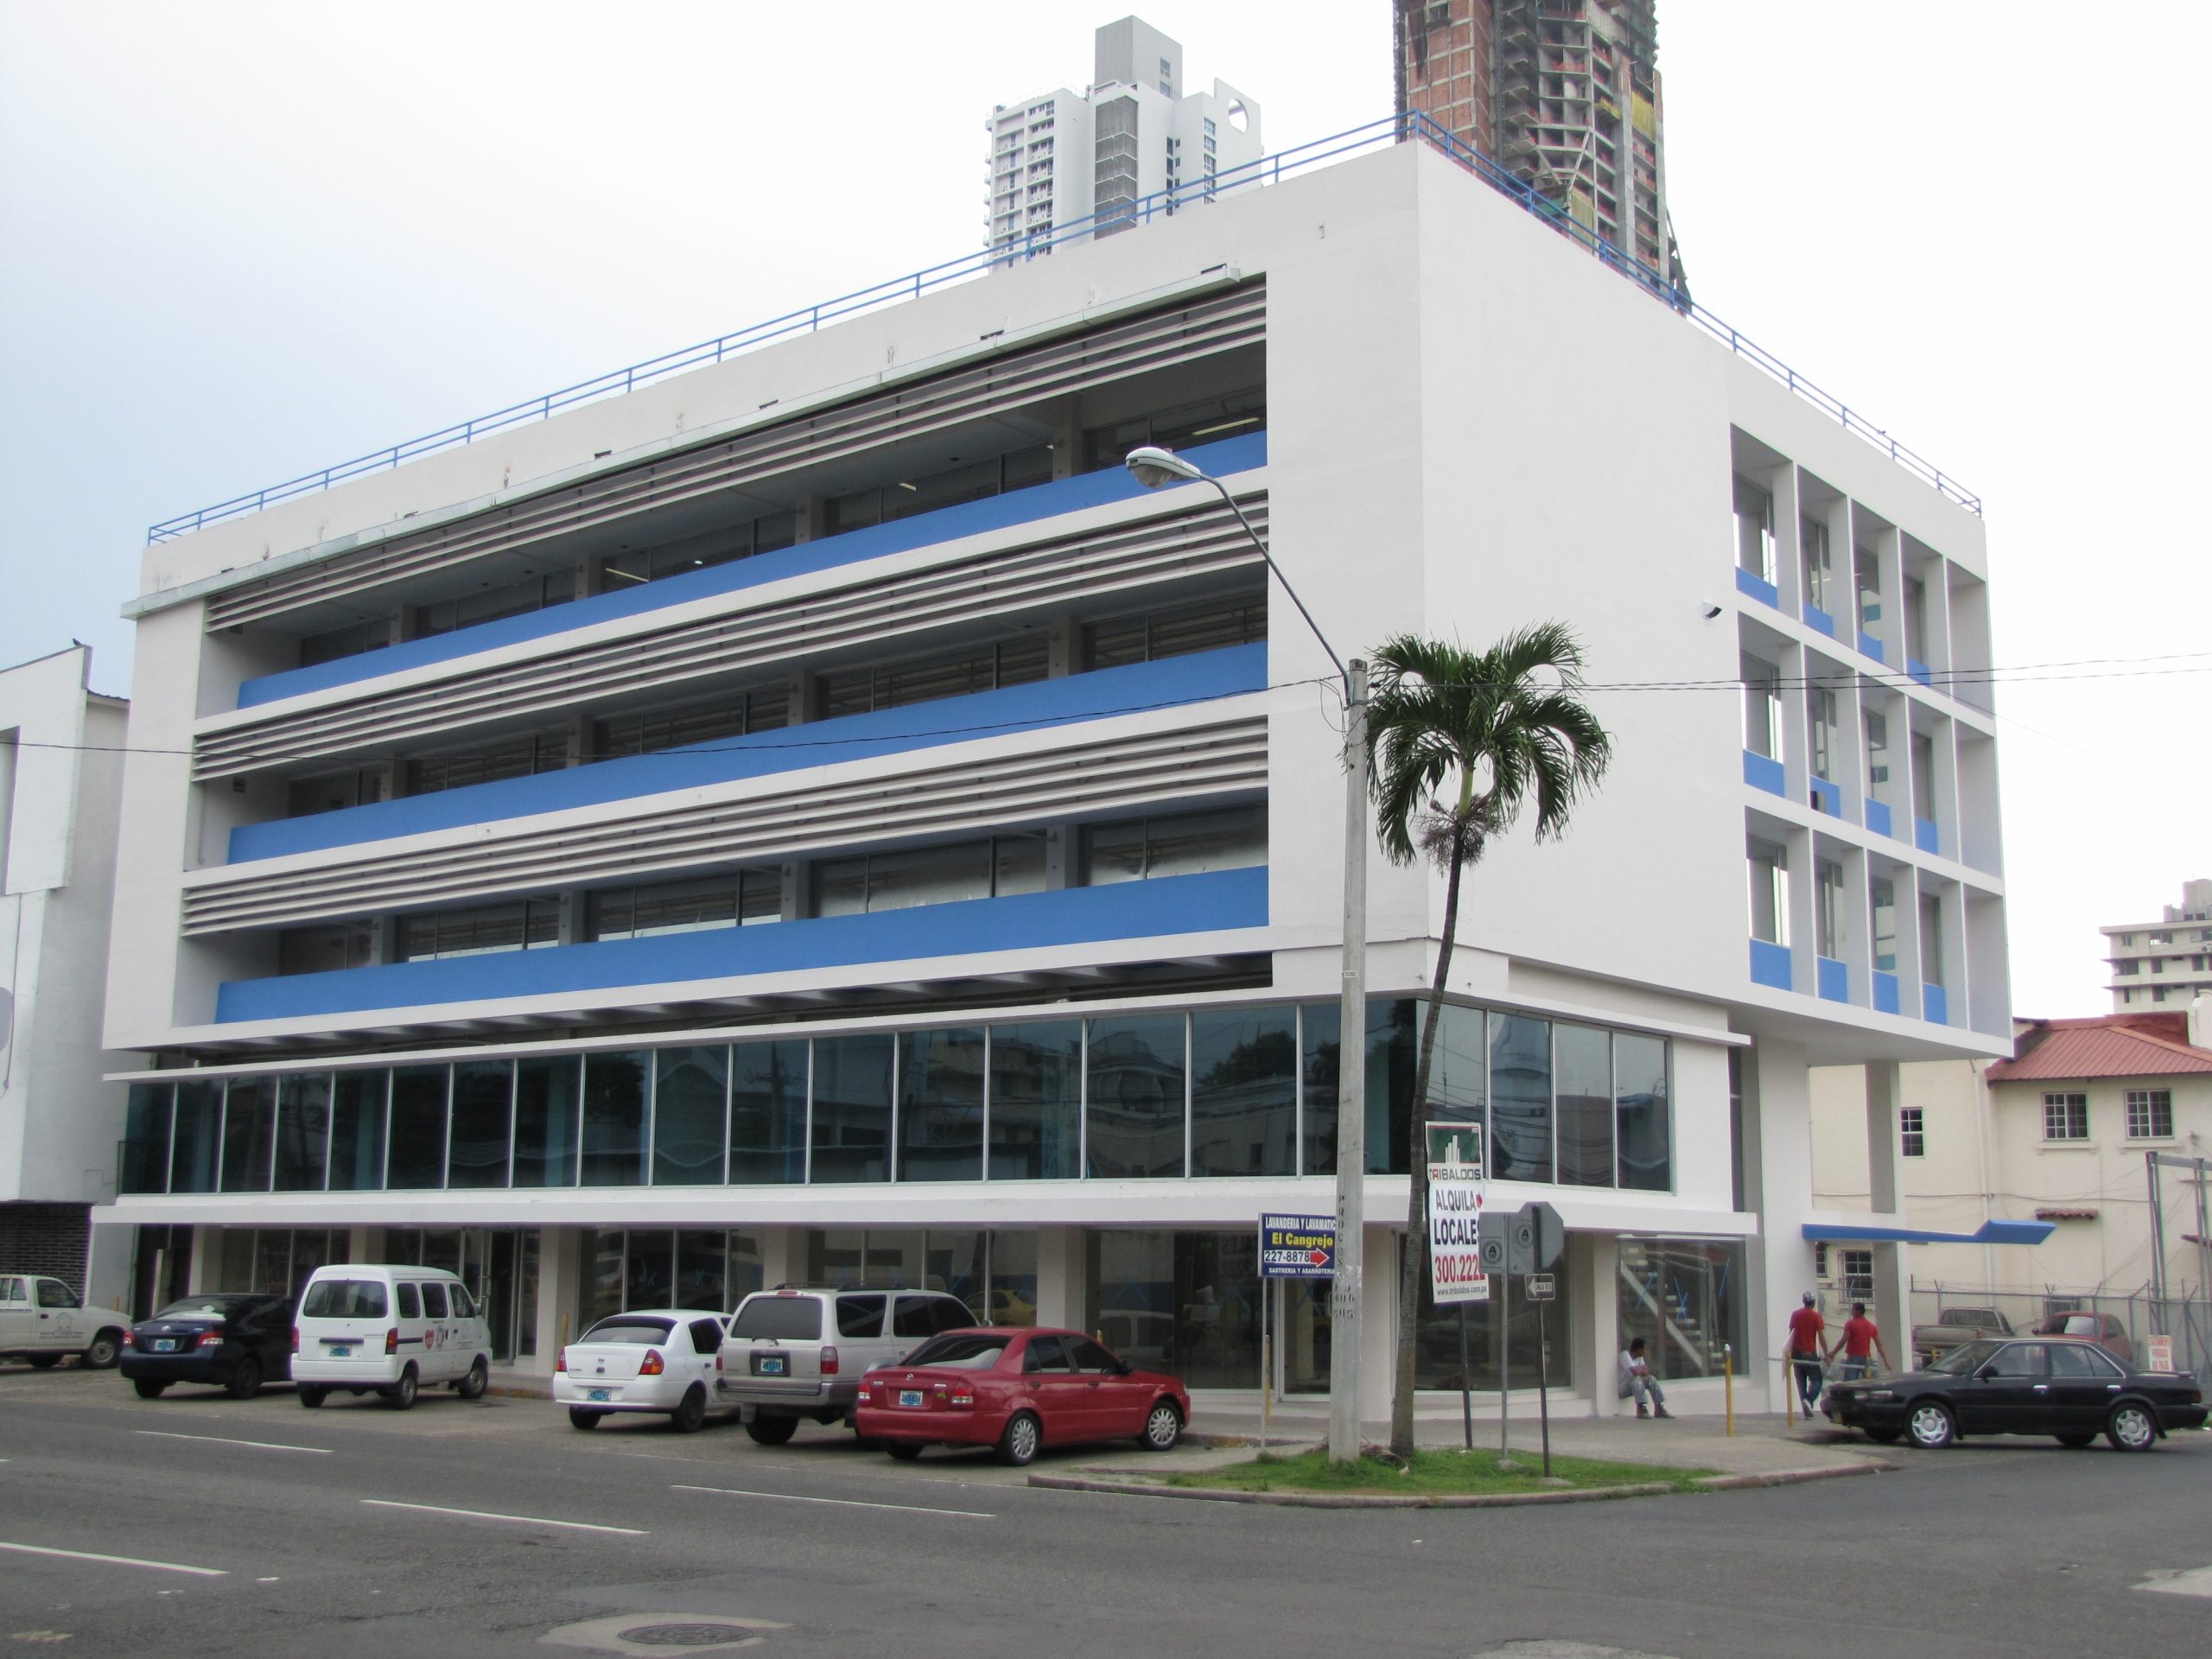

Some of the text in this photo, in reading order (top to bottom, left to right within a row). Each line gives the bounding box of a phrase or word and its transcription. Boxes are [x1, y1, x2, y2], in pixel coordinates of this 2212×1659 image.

[1429, 1168, 1481, 1180] TRIBALDOS
[1435, 1189, 1477, 1211] ALQUILA
[1265, 1216, 1336, 1231] LAVANDERIA Y LAVAMATIC
[1433, 1217, 1479, 1246] LOCALE
[1272, 1232, 1333, 1249] El Cangrejo
[1264, 1250, 1310, 1262] 227-8878
[1434, 1254, 1485, 1283] 300.222
